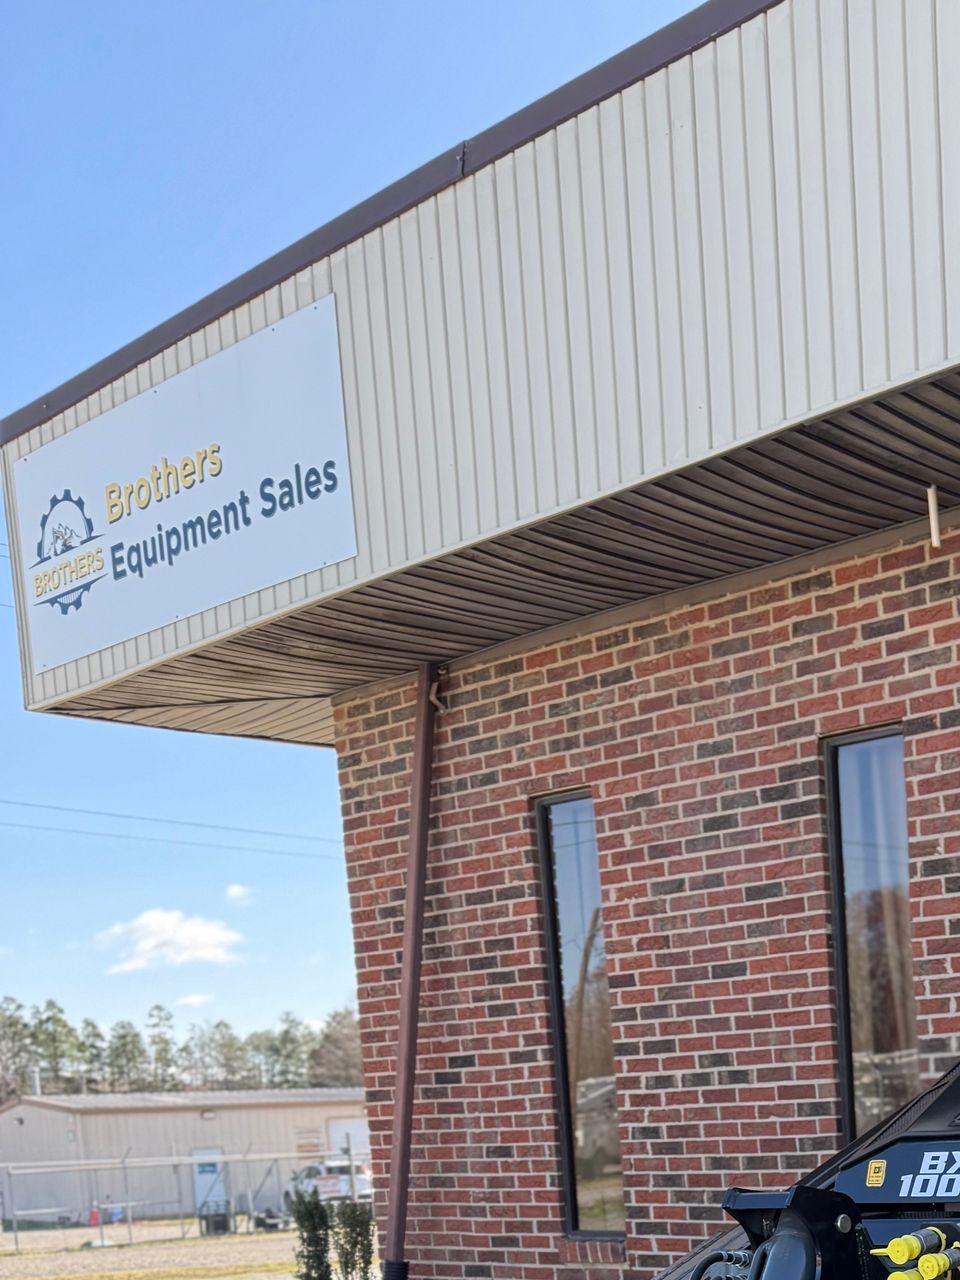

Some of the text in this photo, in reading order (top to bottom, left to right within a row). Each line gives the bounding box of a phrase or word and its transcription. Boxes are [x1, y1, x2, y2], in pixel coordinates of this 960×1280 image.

[105, 442, 223, 523] Brothers
[111, 459, 338, 580] Equipment Sales
[33, 546, 105, 598] BROTHERS
